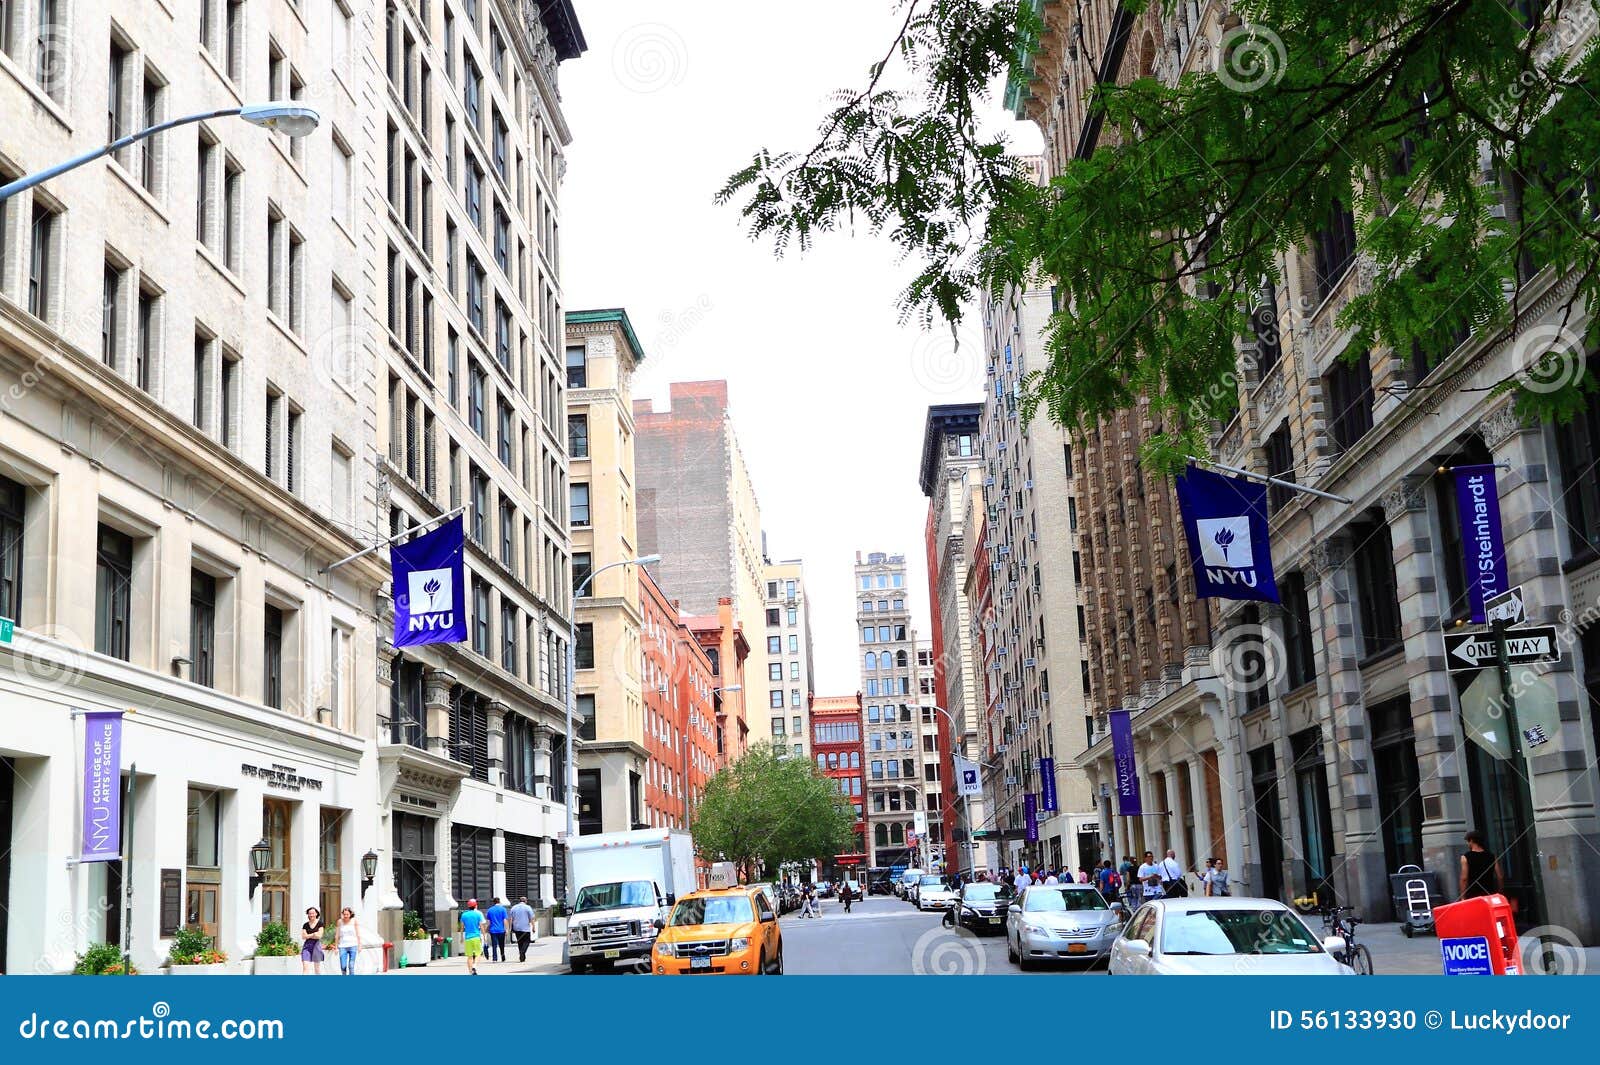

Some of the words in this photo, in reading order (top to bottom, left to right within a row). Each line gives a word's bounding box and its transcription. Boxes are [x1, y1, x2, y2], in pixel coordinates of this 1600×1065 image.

[1468, 475, 1498, 602] YUSteinhardt
[1206, 569, 1257, 588] NYU
[409, 613, 454, 632] NYU
[1466, 643, 1497, 658] ONE
[1508, 638, 1541, 654] WAY
[94, 740, 102, 755] OF
[103, 723, 112, 766] SCIENCE
[93, 757, 102, 804] COLLEGE
[102, 776, 111, 803] ARTS
[93, 807, 110, 851] NYU
[1448, 944, 1487, 960] VOICE
